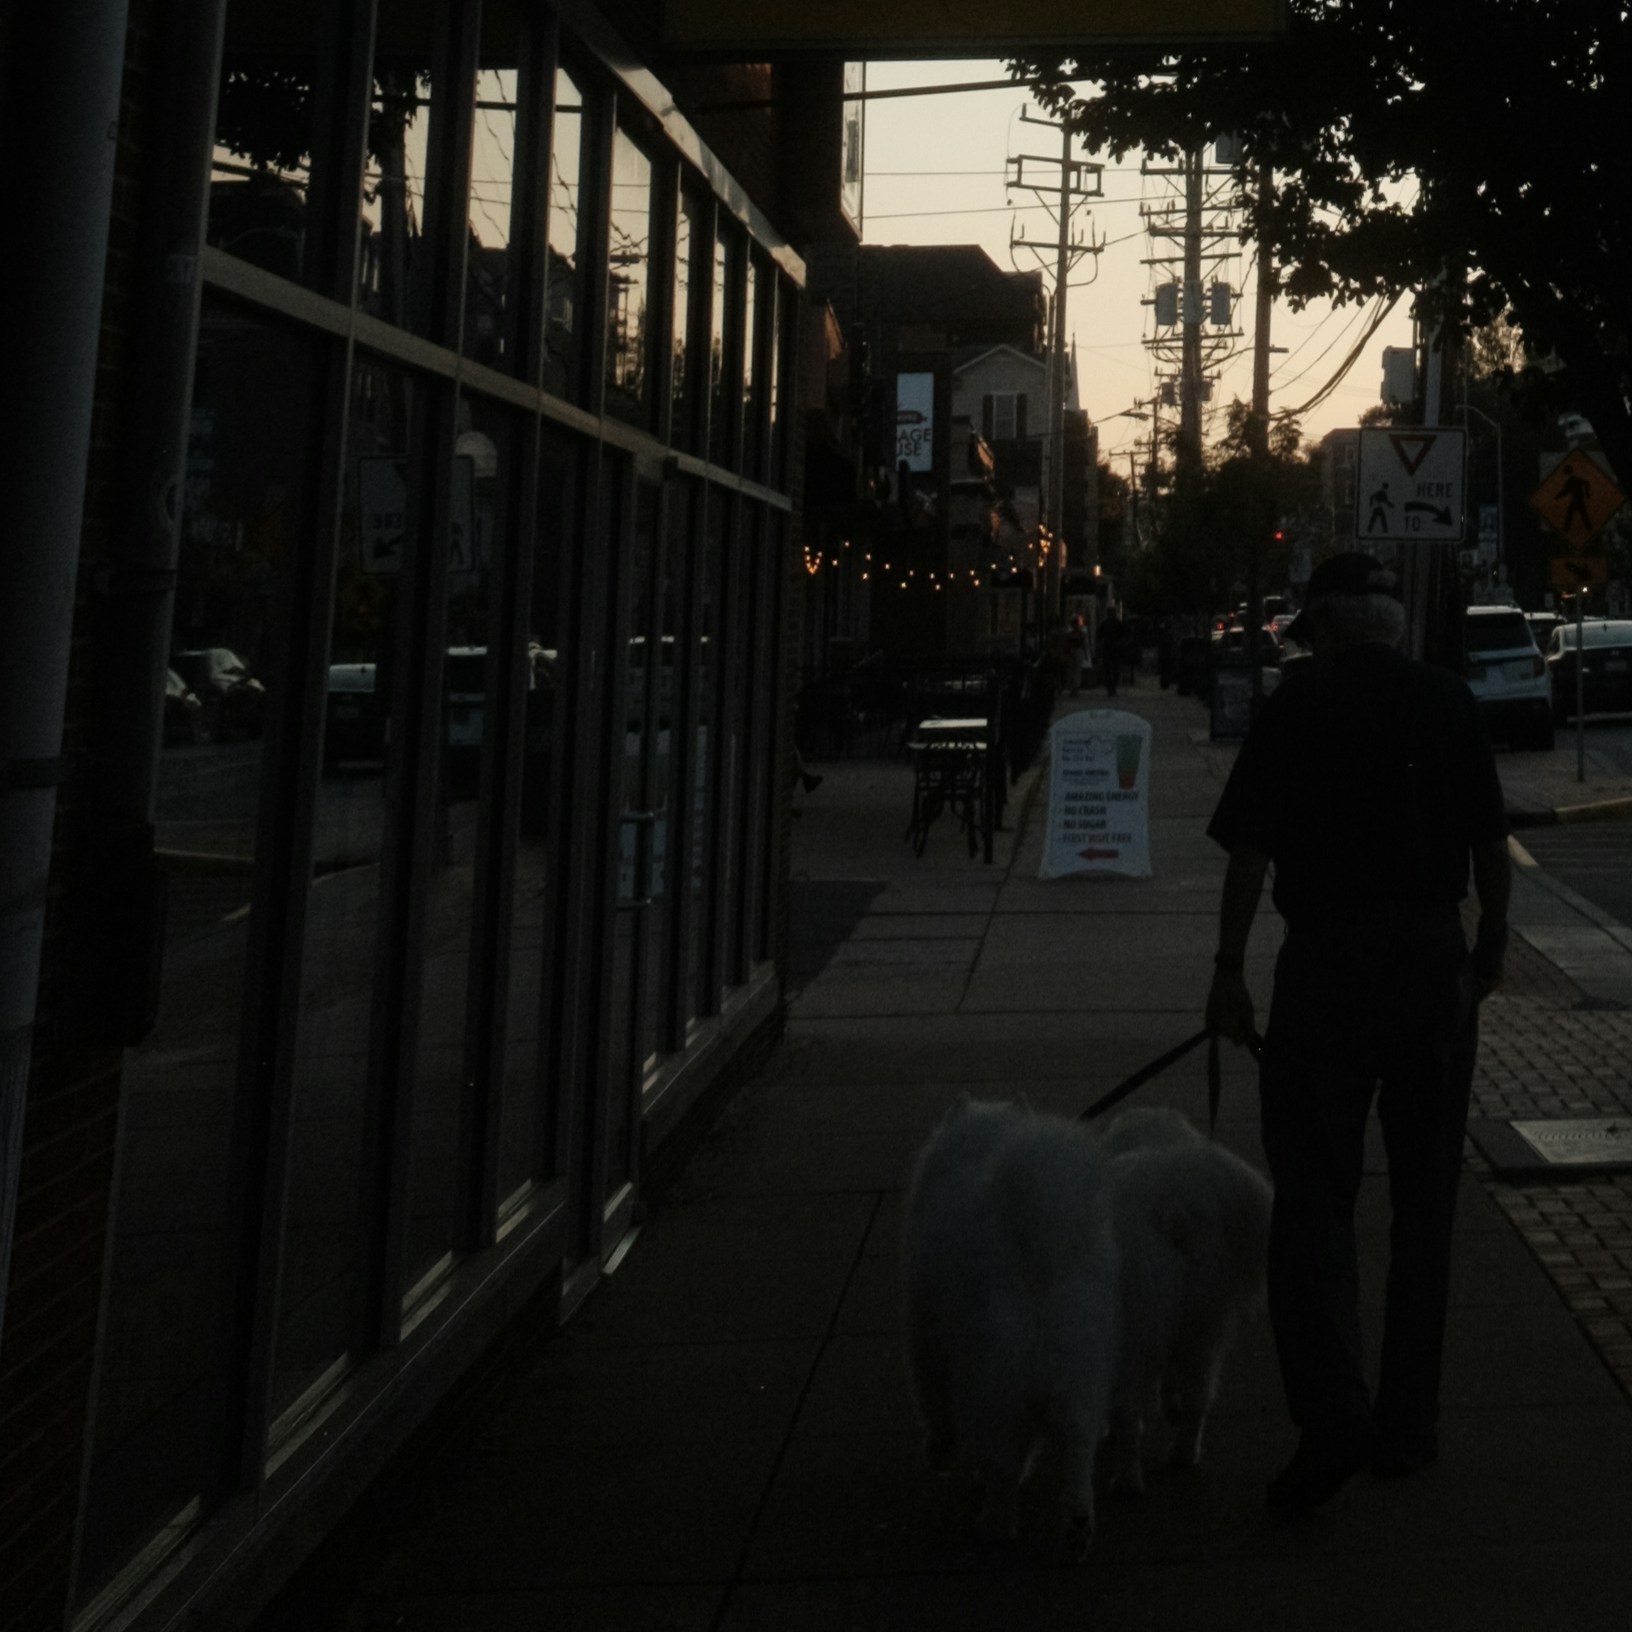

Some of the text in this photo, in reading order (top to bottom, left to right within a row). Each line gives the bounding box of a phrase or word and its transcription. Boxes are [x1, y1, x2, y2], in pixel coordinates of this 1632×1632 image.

[1416, 481, 1454, 499] HERE
[1403, 515, 1421, 532] TO
[1064, 791, 1105, 802] AMAZING
[1064, 805, 1077, 816] NO
[1063, 819, 1107, 830] NO SUGAR
